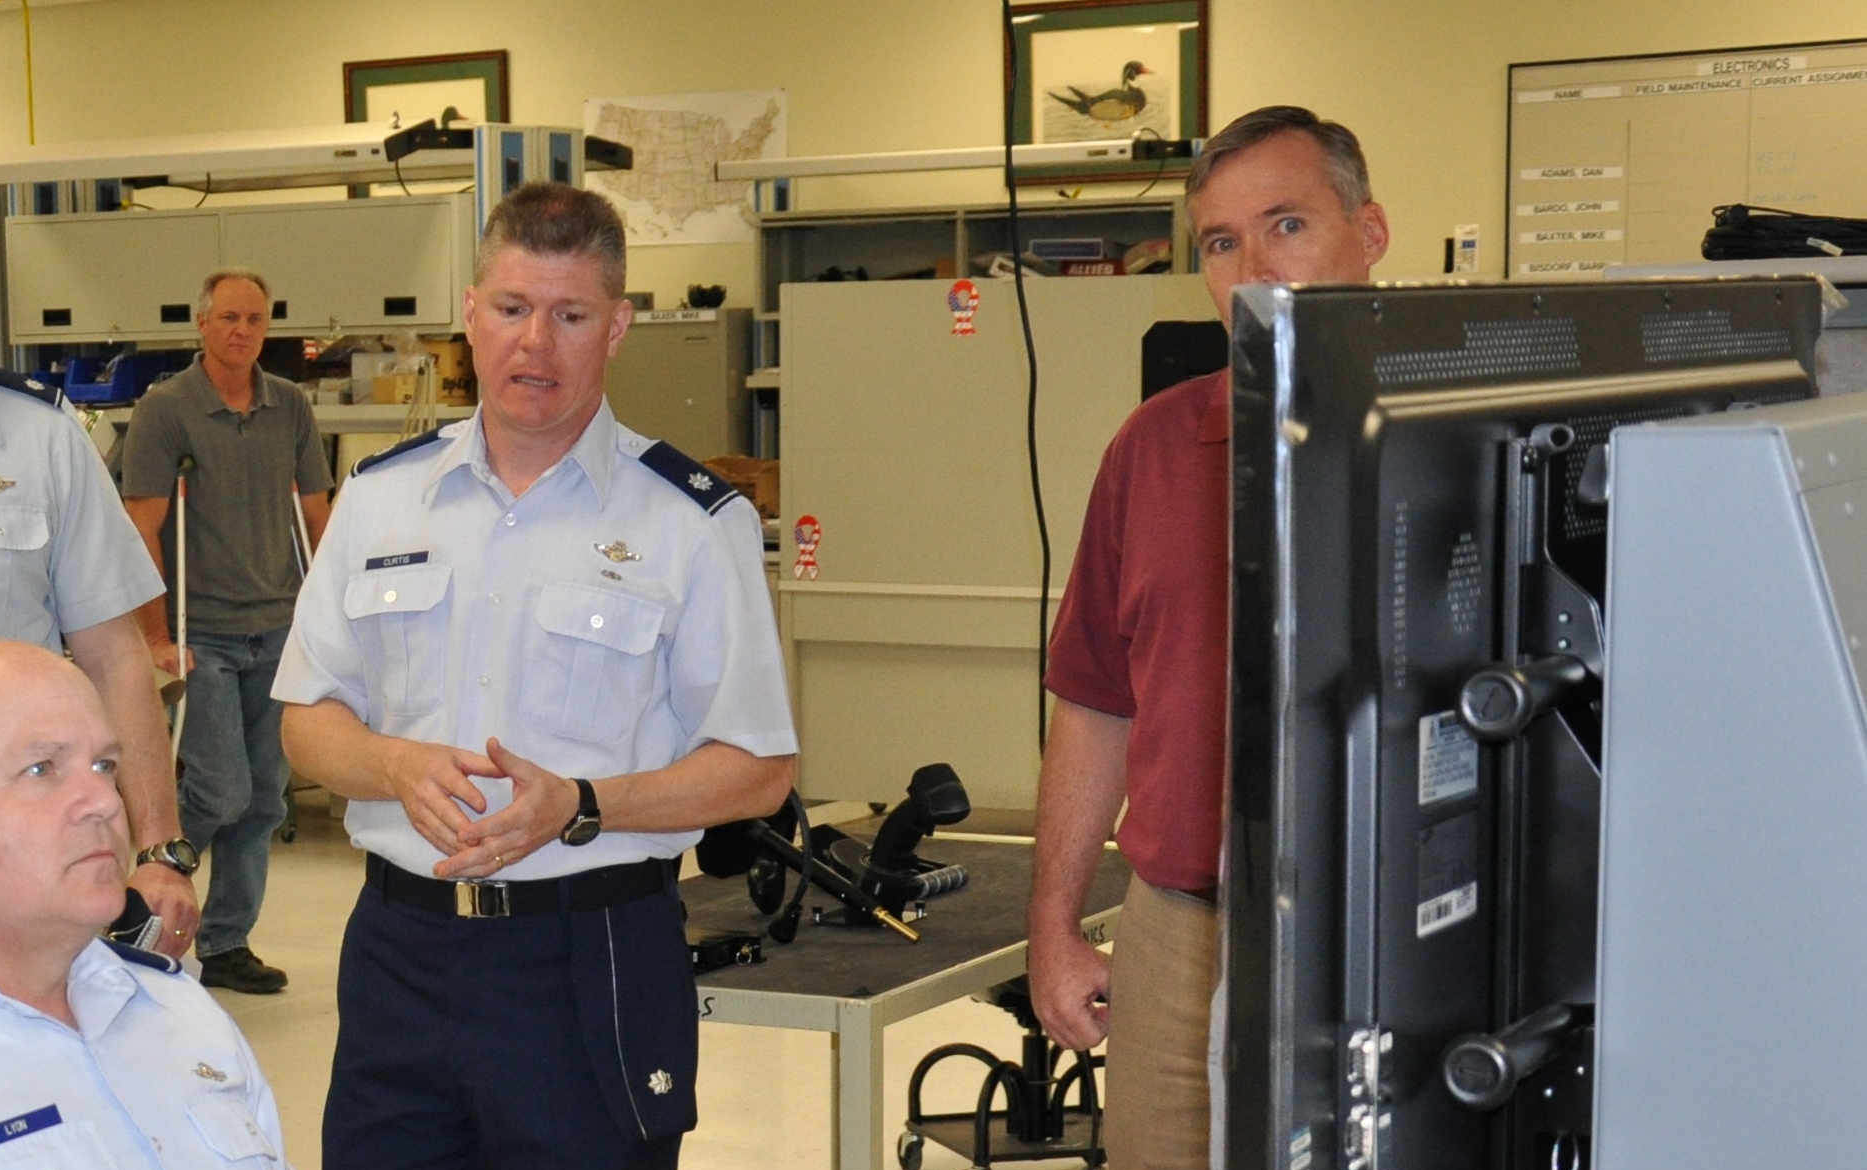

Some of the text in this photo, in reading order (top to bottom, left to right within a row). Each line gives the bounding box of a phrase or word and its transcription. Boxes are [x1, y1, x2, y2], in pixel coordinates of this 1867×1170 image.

[1713, 57, 1790, 75] ELECTRONICS
[1635, 78, 1742, 93] FIELD MAINTENANCE
[1753, 74, 1804, 87] CURRENT
[1554, 90, 1583, 99] NAME
[1066, 263, 1115, 276] ALLIED
[383, 555, 410, 567] CURTIS
[3, 1118, 29, 1136] LYON
